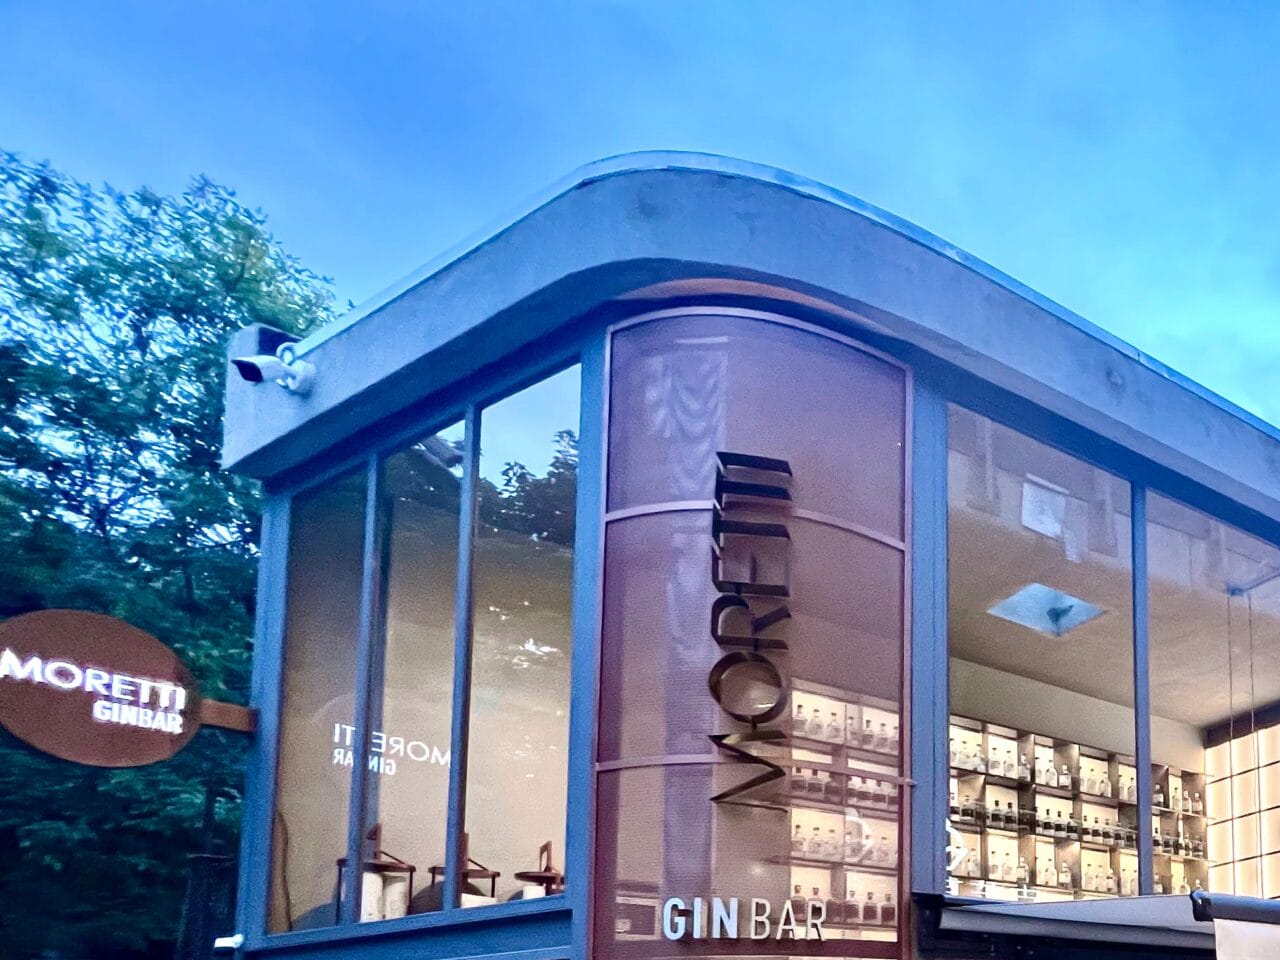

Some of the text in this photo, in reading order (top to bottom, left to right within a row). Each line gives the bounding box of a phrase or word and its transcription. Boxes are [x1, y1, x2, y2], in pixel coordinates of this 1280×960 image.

[708, 451, 793, 813] MORETTI
[0, 647, 187, 711] MORETTI
[92, 699, 184, 735] GINBAR
